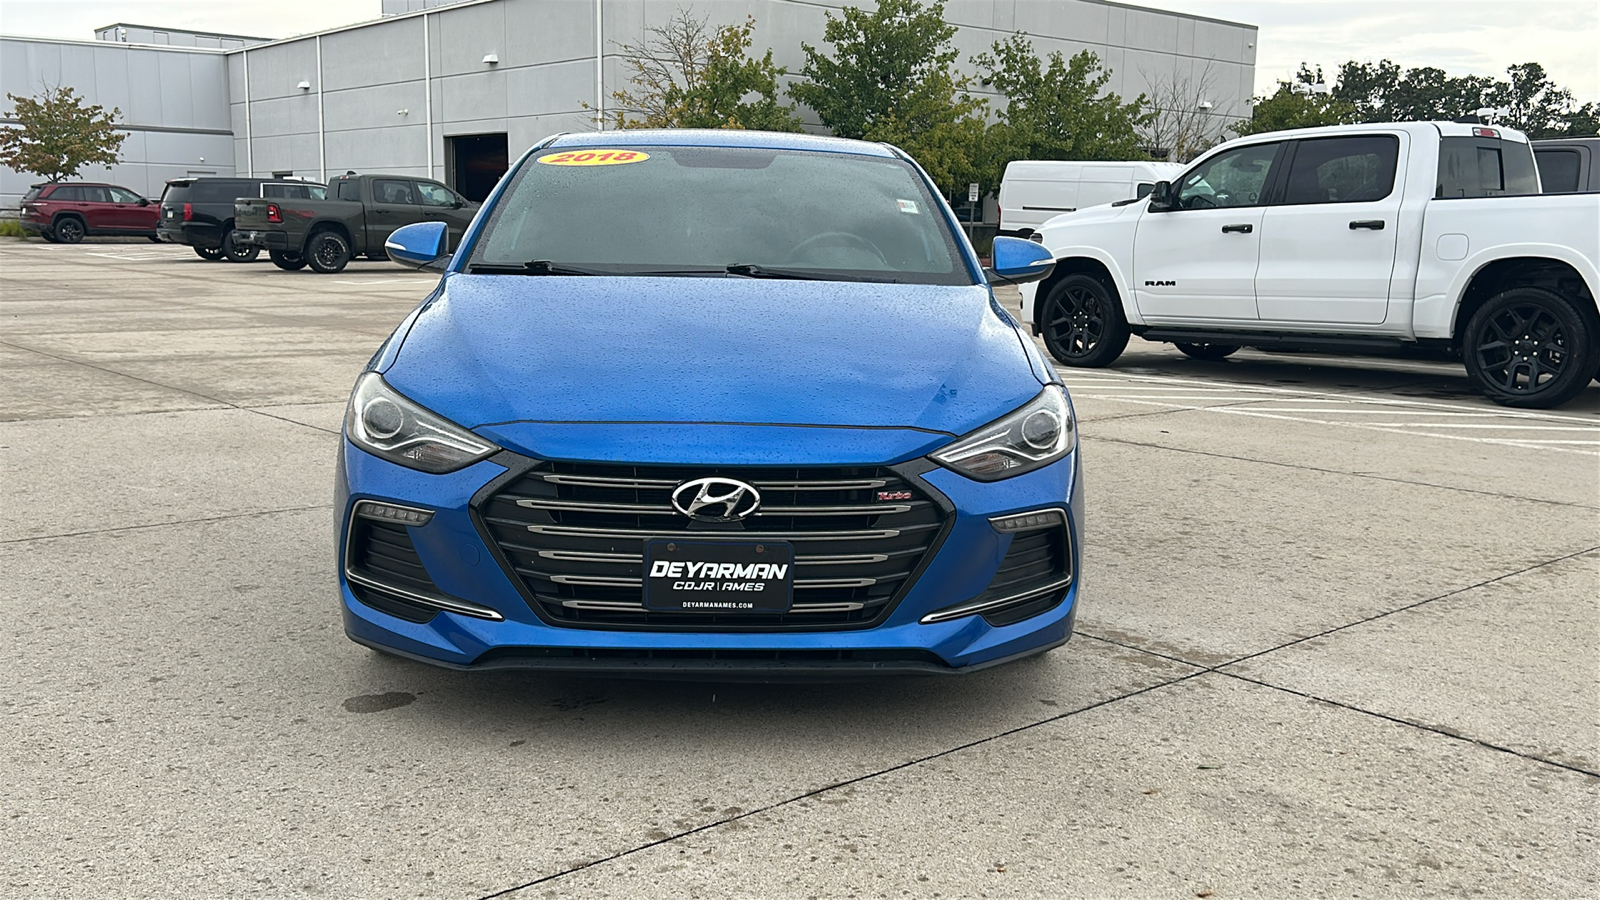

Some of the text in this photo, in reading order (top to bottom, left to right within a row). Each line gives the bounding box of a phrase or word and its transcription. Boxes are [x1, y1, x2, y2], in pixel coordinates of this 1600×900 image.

[548, 152, 638, 163] 2018
[877, 491, 912, 500] Turbo
[649, 560, 788, 580] DEYARMAN
[672, 581, 766, 591] CDJR AMES
[682, 601, 754, 609] DEYARMANAMES.COM
